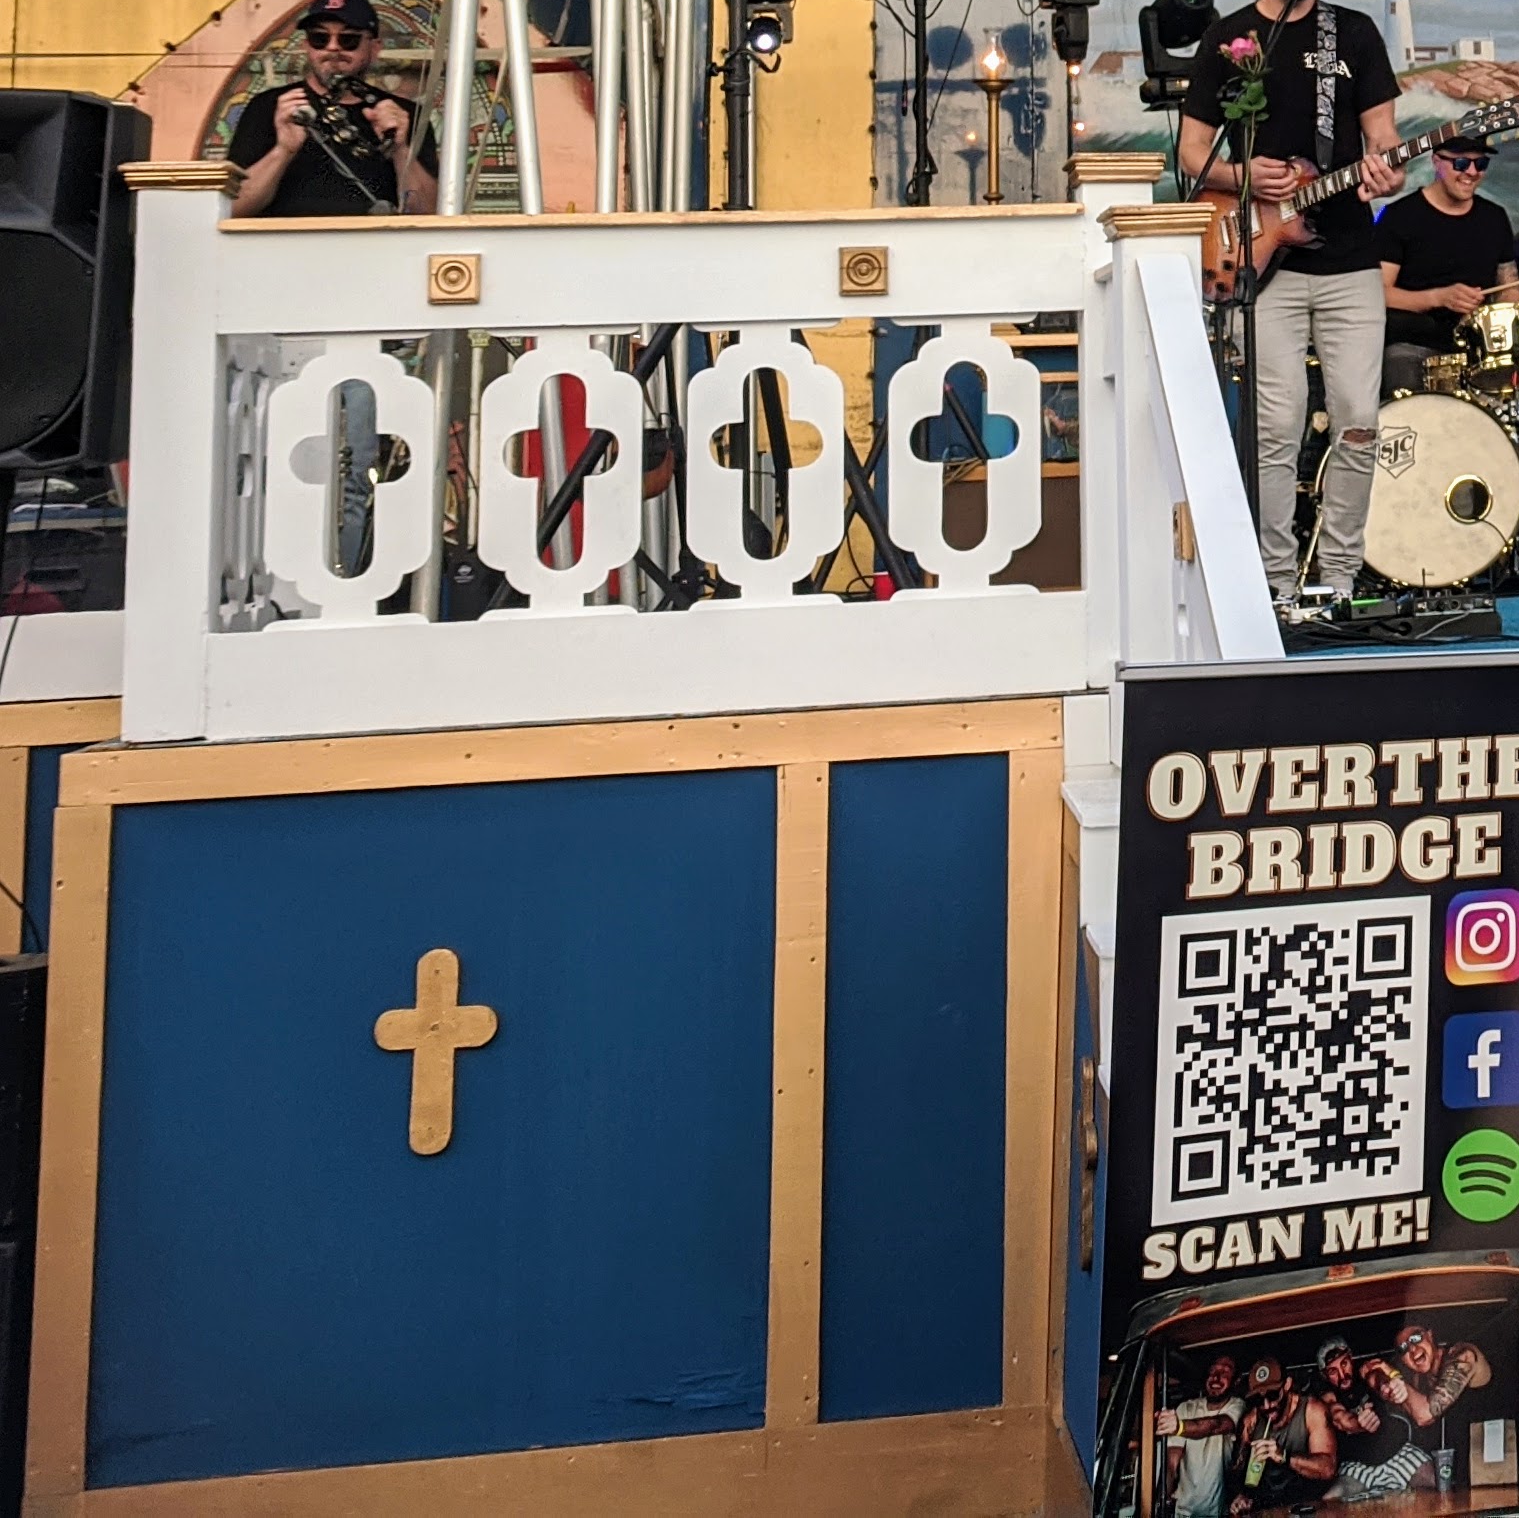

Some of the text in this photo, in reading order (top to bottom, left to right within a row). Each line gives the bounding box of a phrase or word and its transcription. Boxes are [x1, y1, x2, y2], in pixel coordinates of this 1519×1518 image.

[1184, 810, 1503, 901] BRIDGE
[1142, 1195, 1432, 1281] SCAN ME!
